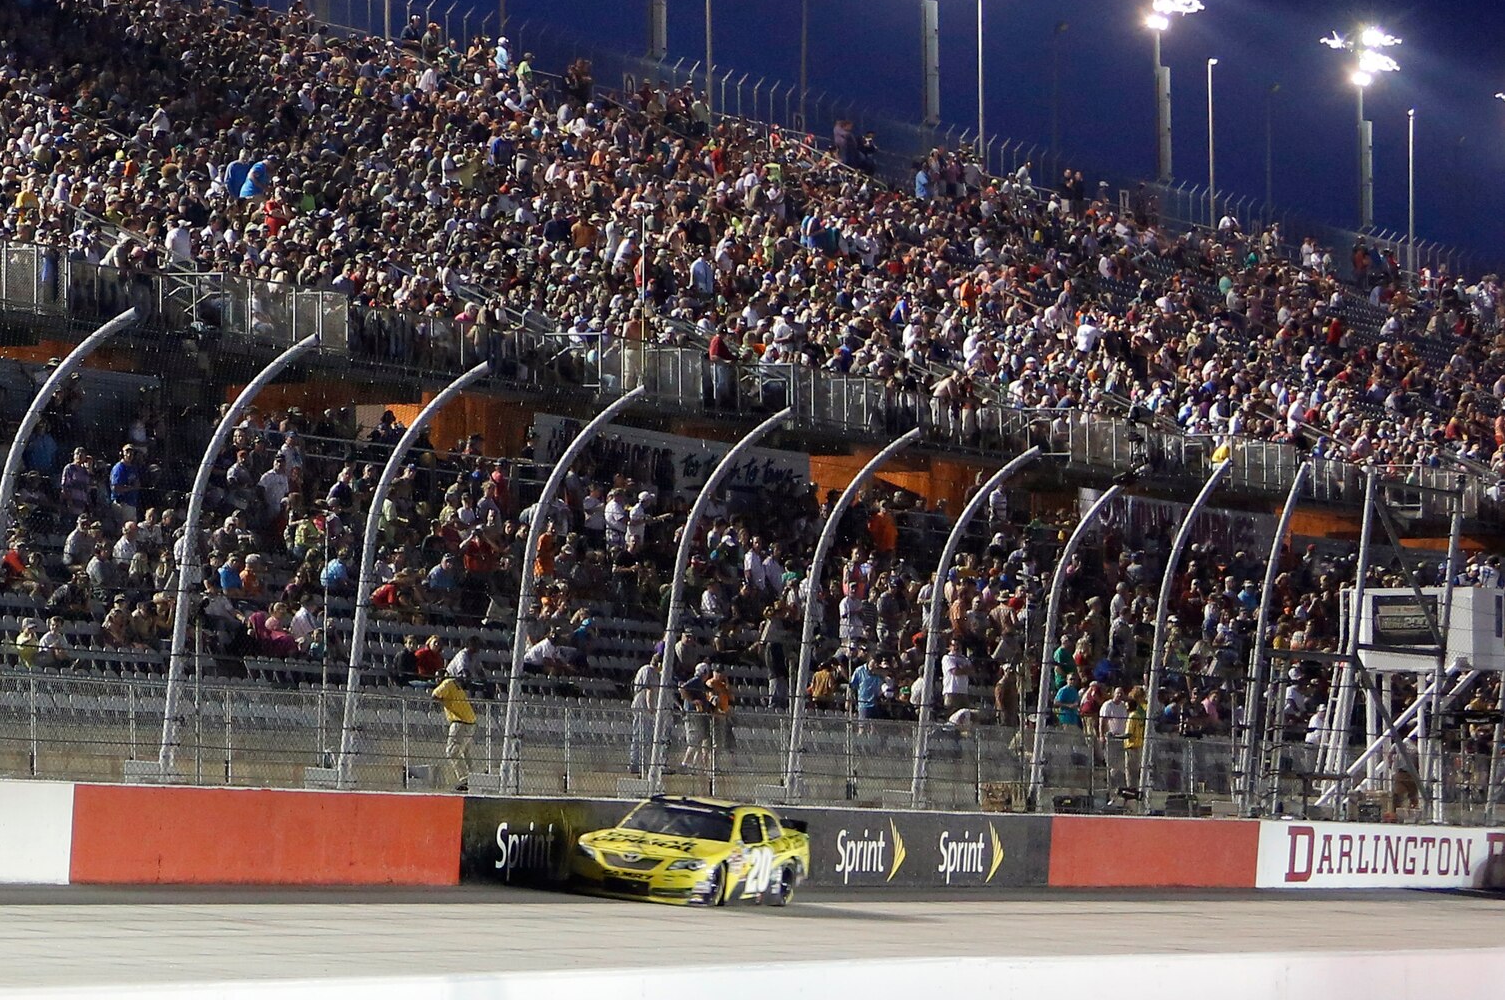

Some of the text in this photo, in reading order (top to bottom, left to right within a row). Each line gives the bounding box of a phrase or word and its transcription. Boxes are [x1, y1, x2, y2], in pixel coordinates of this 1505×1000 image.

[495, 821, 555, 882] Sprint
[744, 846, 774, 893] 20
[835, 828, 886, 885] Sprint
[938, 830, 985, 885] Sprint
[1284, 825, 1472, 882] DARLINGTON
